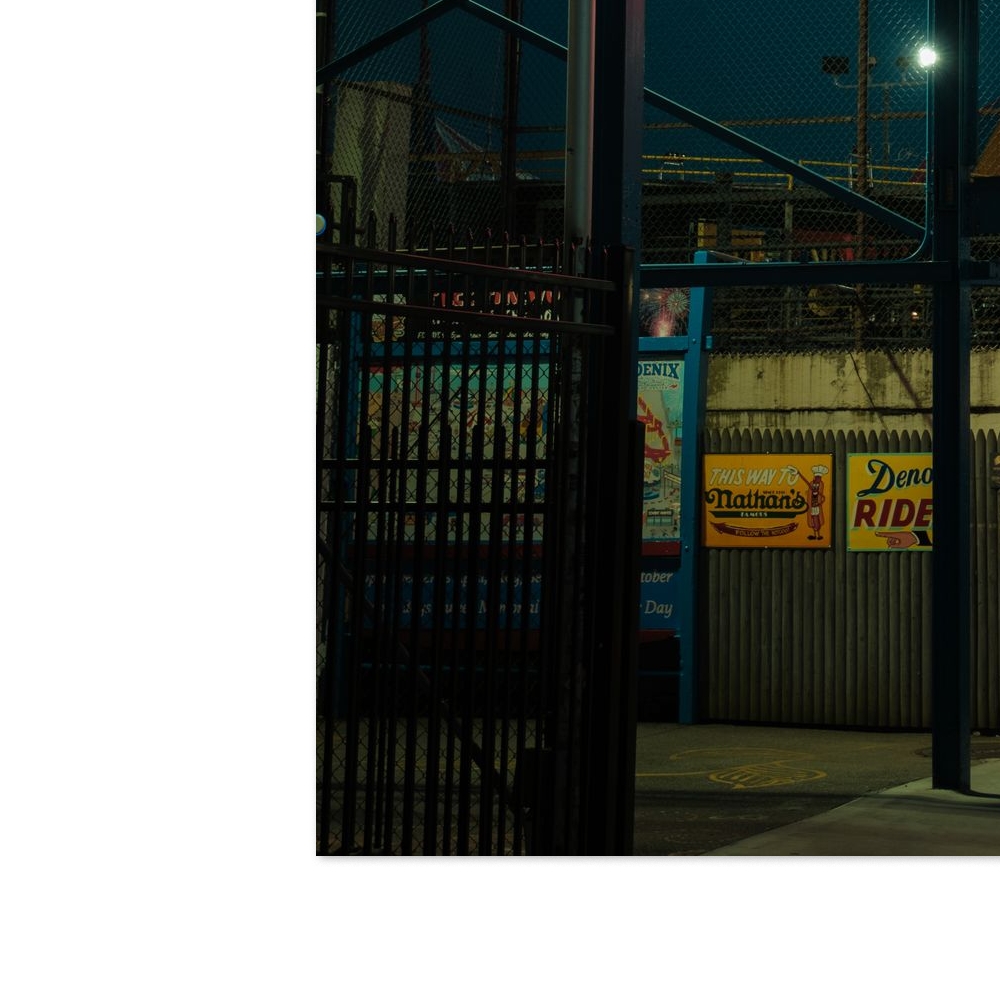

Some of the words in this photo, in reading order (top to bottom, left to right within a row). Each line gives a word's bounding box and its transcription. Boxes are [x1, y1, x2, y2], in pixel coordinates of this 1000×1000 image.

[709, 467, 745, 486] THIS
[745, 467, 777, 486] WAY
[777, 466, 800, 487] TO
[856, 459, 933, 497] Deno
[704, 487, 808, 509] Nathan's
[643, 599, 674, 619] Day
